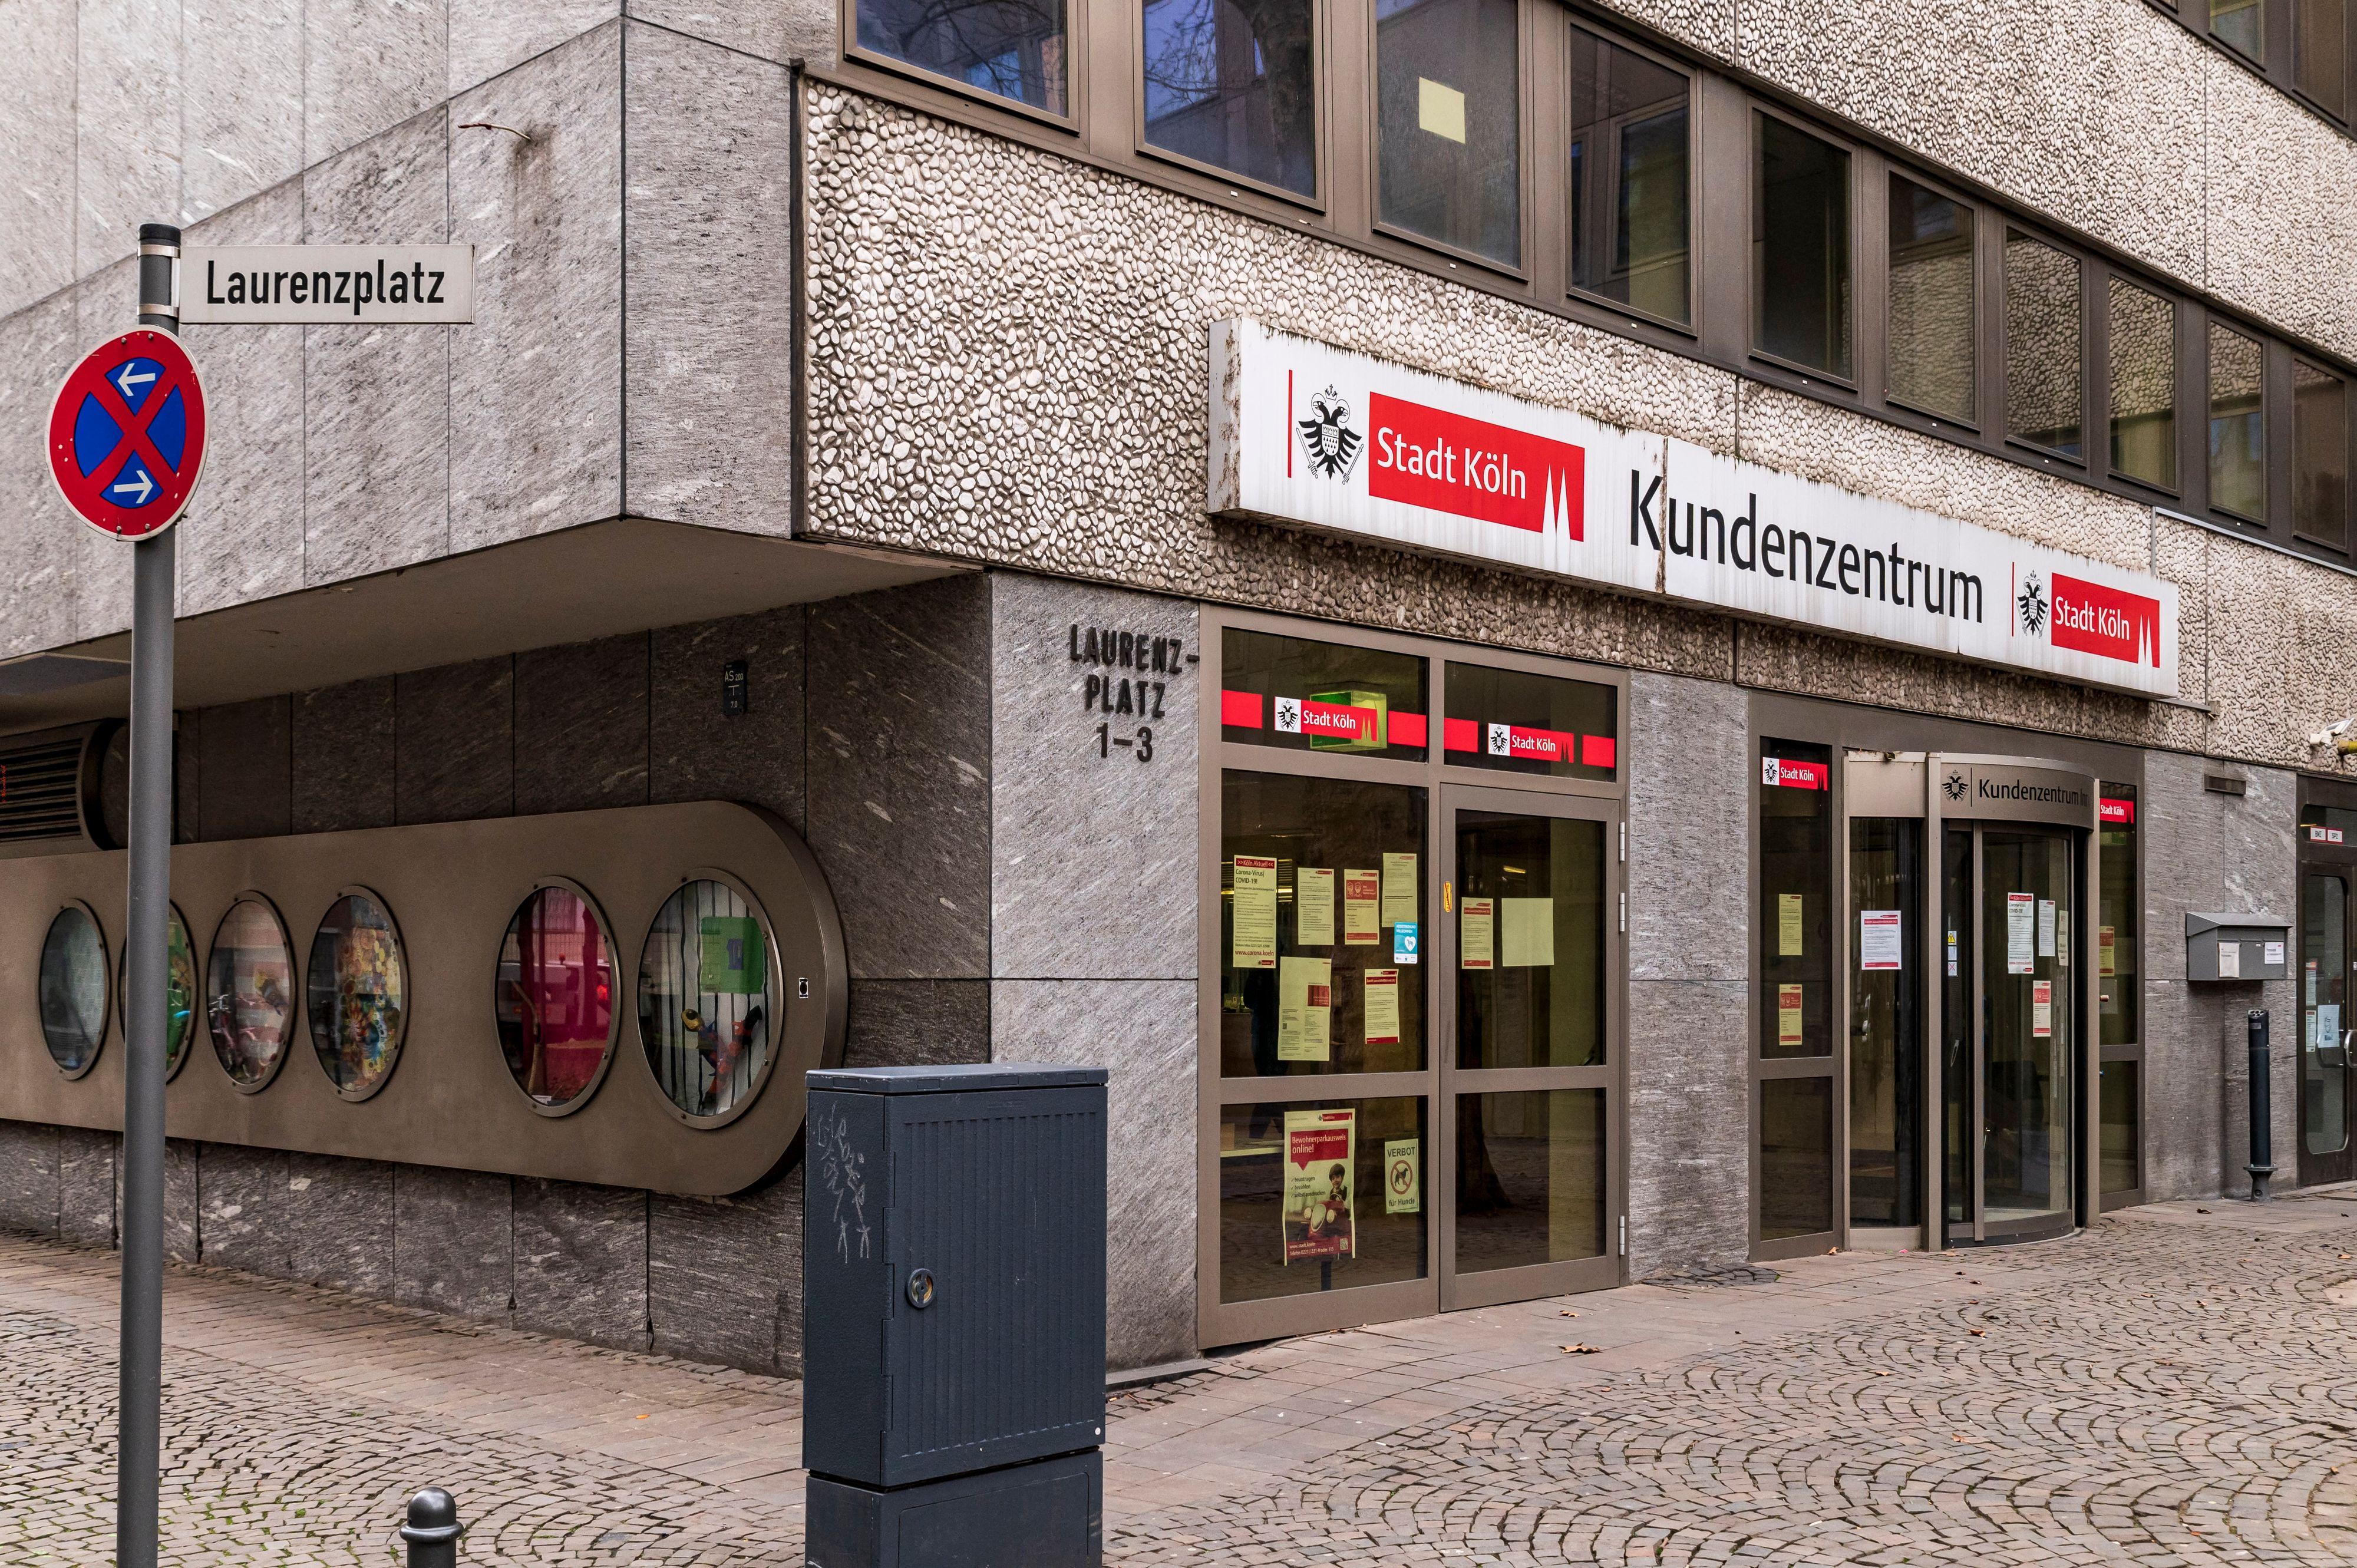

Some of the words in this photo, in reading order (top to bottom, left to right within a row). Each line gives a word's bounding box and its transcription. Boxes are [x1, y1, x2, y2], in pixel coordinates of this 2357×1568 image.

[207, 259, 445, 316] Laurenzplatz
[1377, 426, 1457, 484] Stadt
[1464, 447, 1526, 500] Köln
[1630, 470, 1983, 623] Kundenzentrum
[2055, 596, 2095, 632] Stadt
[2098, 608, 2130, 641] Köln
[1069, 623, 1200, 674] LAURENZ-
[724, 670, 734, 682] AS
[1085, 674, 1165, 717] PLATZ
[1303, 709, 1331, 727] Stadt
[1333, 714, 1356, 729] Köln
[1511, 735, 1535, 750] Stadt
[1536, 738, 1556, 752] Köln
[1780, 767, 1798, 780] Stadt
[1799, 769, 1814, 781] Köln
[1979, 778, 2079, 804] Kundenzentrum
[2100, 804, 2114, 816] Stadt
[2113, 806, 2124, 817] Köln
[1292, 1134, 1346, 1144] Bewohnerparkausweis
[1292, 1144, 1314, 1154] online!
[1387, 1147, 1415, 1157] VERBOT
[1398, 1197, 1415, 1206] Hunde
